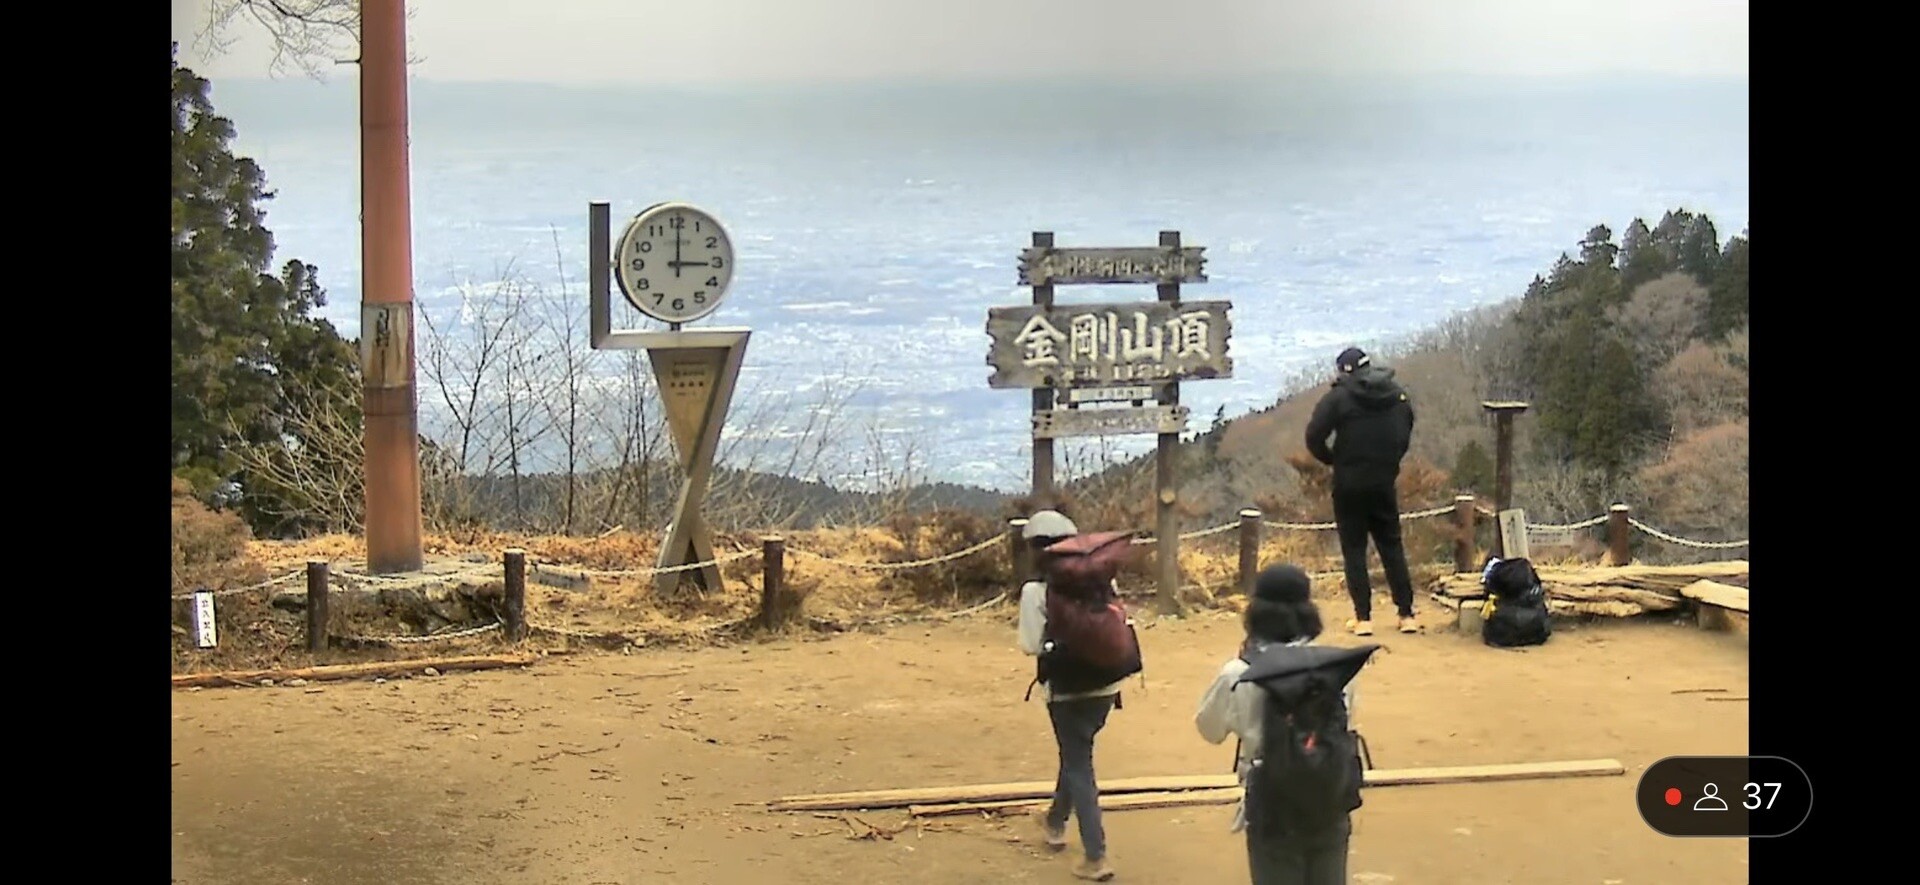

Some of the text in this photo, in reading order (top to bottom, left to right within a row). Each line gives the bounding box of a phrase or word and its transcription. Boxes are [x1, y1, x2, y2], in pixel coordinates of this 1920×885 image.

[669, 217, 685, 229] 12
[695, 221, 700, 232] 1
[649, 225, 663, 237] 11
[635, 241, 652, 253] 10
[705, 236, 718, 249] 2
[632, 258, 645, 271] 9
[711, 256, 724, 269] 3
[637, 278, 650, 290] 8
[705, 276, 719, 287] 4
[652, 293, 665, 305] 7
[694, 291, 706, 303] 5
[672, 298, 684, 311] 6
[1013, 310, 1212, 367] 金剛山頂
